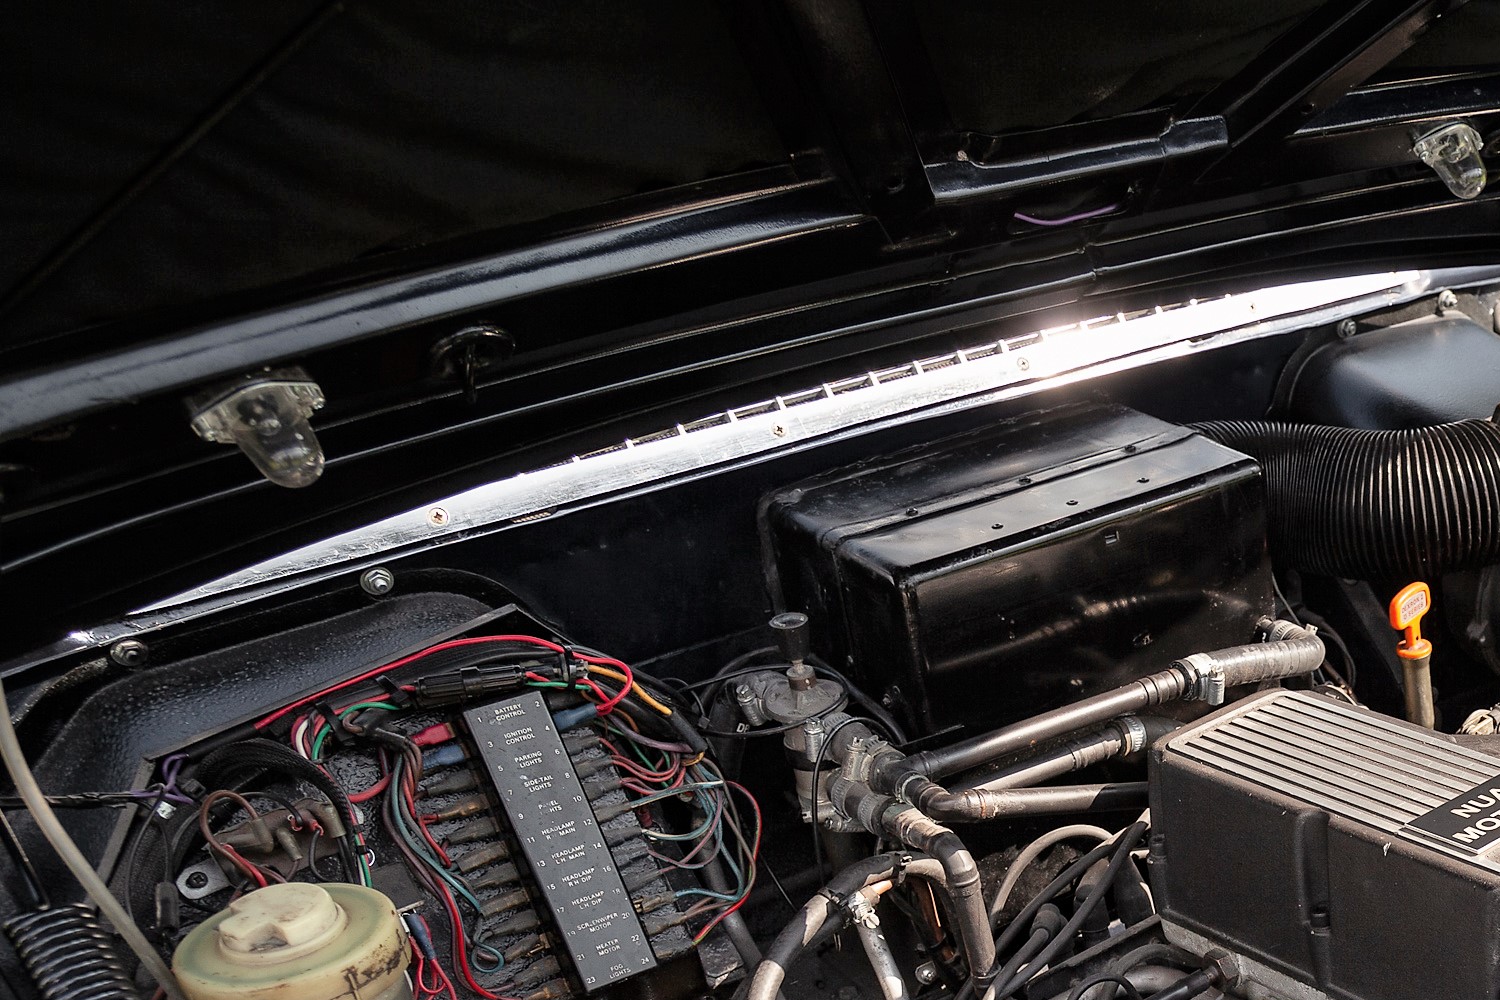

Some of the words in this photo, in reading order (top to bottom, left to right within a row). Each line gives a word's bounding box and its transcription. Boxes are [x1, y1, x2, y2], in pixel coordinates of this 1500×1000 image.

[494, 704, 522, 715] BATTERY
[534, 700, 540, 708] 2
[496, 709, 526, 721] CONTROL
[504, 726, 532, 739] IGNITION
[506, 732, 536, 745] CONTROL
[514, 750, 542, 763] PARKING
[520, 757, 542, 768] LIGHTS
[524, 775, 554, 788] SIDE-TAIL
[528, 781, 552, 792] LIGHTS
[541, 820, 575, 835] HEADLAMP
[583, 818, 592, 826] 12
[558, 827, 576, 836] MAIN
[526, 836, 536, 844] 11
[593, 842, 602, 850] 14
[551, 844, 585, 860] HEADLAMP
[568, 851, 586, 860] MAIN
[562, 868, 595, 882] HEADLAMP
[581, 875, 592, 883] DIP
[572, 890, 605, 906] HEADLAMP
[592, 898, 602, 906] DIP
[556, 906, 565, 914] 17
[622, 912, 630, 920] 20
[589, 921, 612, 933] MOTOR
[630, 934, 640, 942] 22
[596, 938, 619, 950] HEATER
[598, 945, 621, 956] MOTOR
[610, 964, 624, 972] FOG
[610, 967, 632, 979] LIGHTS
[586, 976, 596, 984] 23
